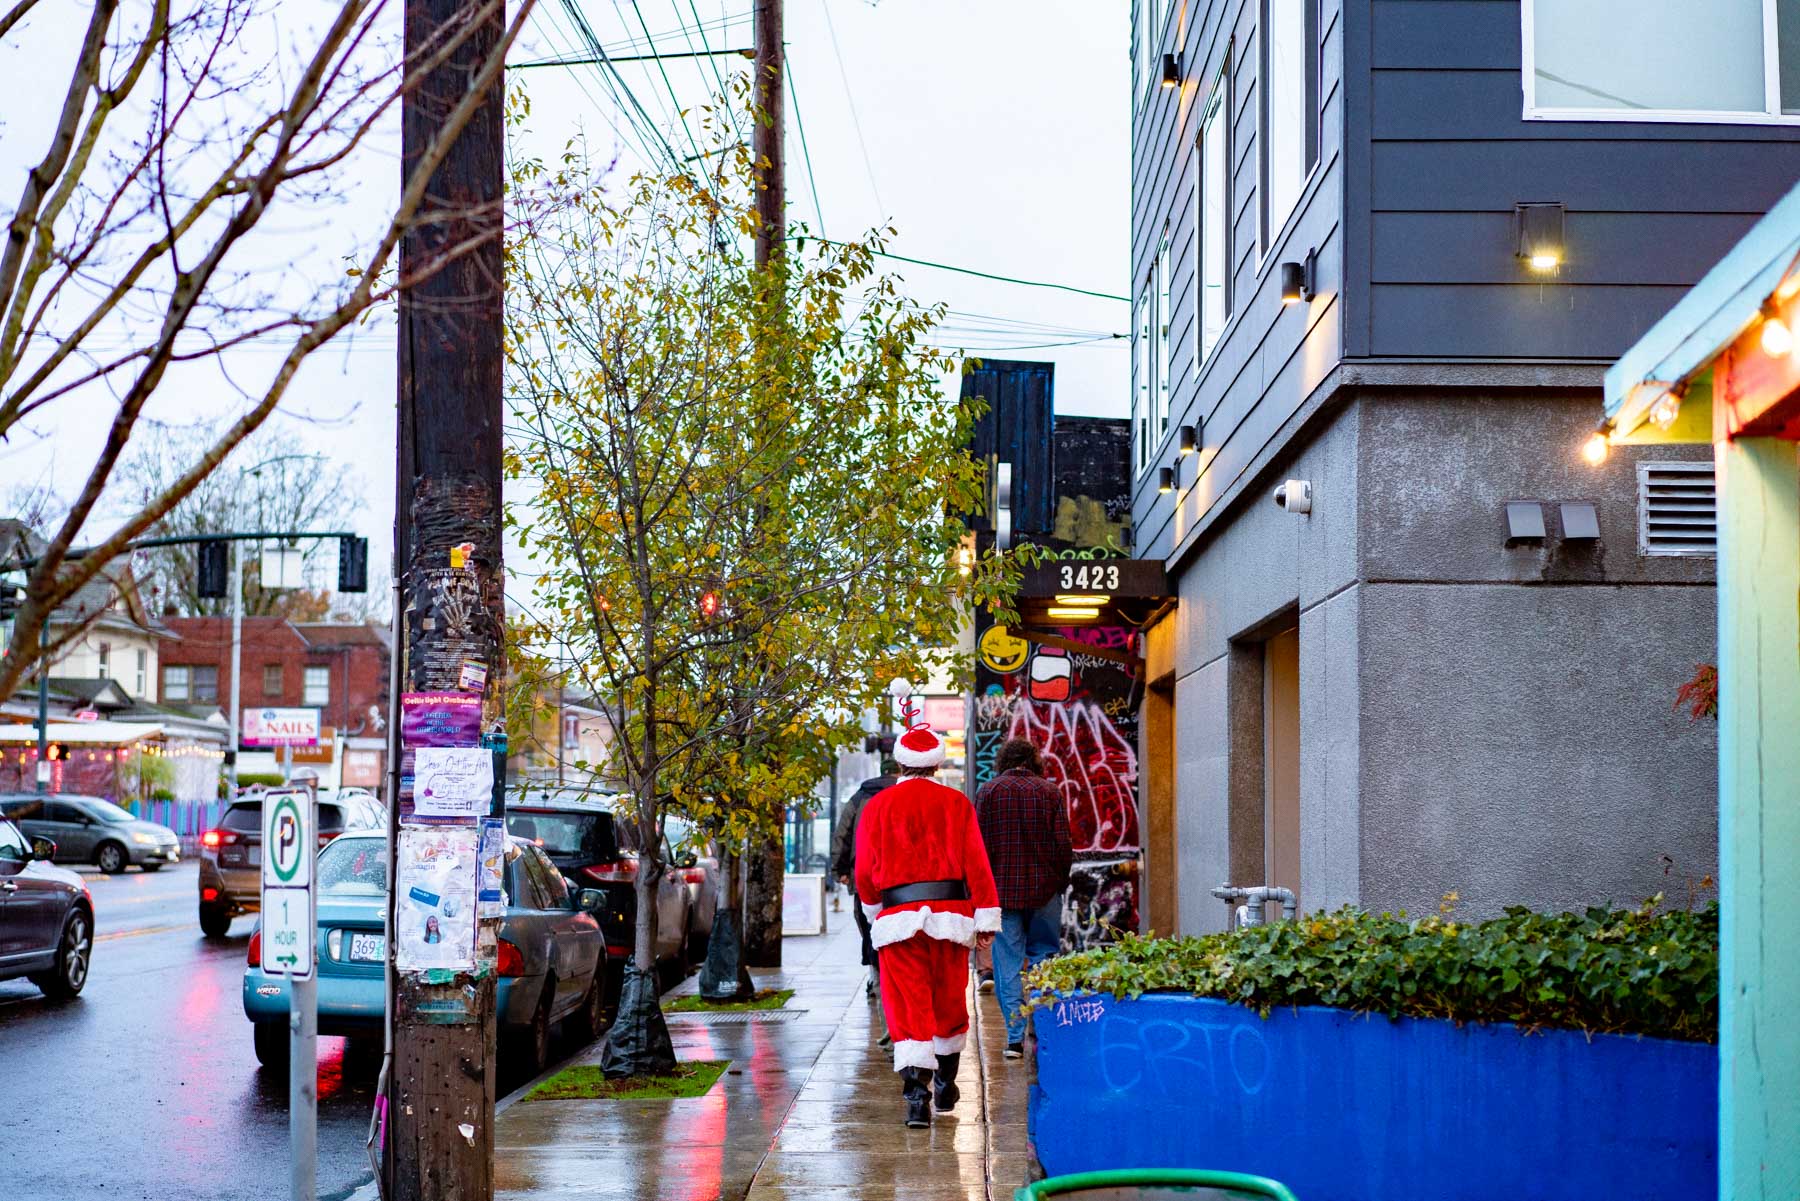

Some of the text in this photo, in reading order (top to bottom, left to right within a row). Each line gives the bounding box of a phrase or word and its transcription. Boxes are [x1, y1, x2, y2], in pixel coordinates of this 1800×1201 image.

[1060, 565, 1119, 590] 3423
[266, 722, 314, 734] NAILS
[280, 816, 295, 865] P
[282, 898, 289, 925] 1
[274, 930, 297, 945] HOUR
